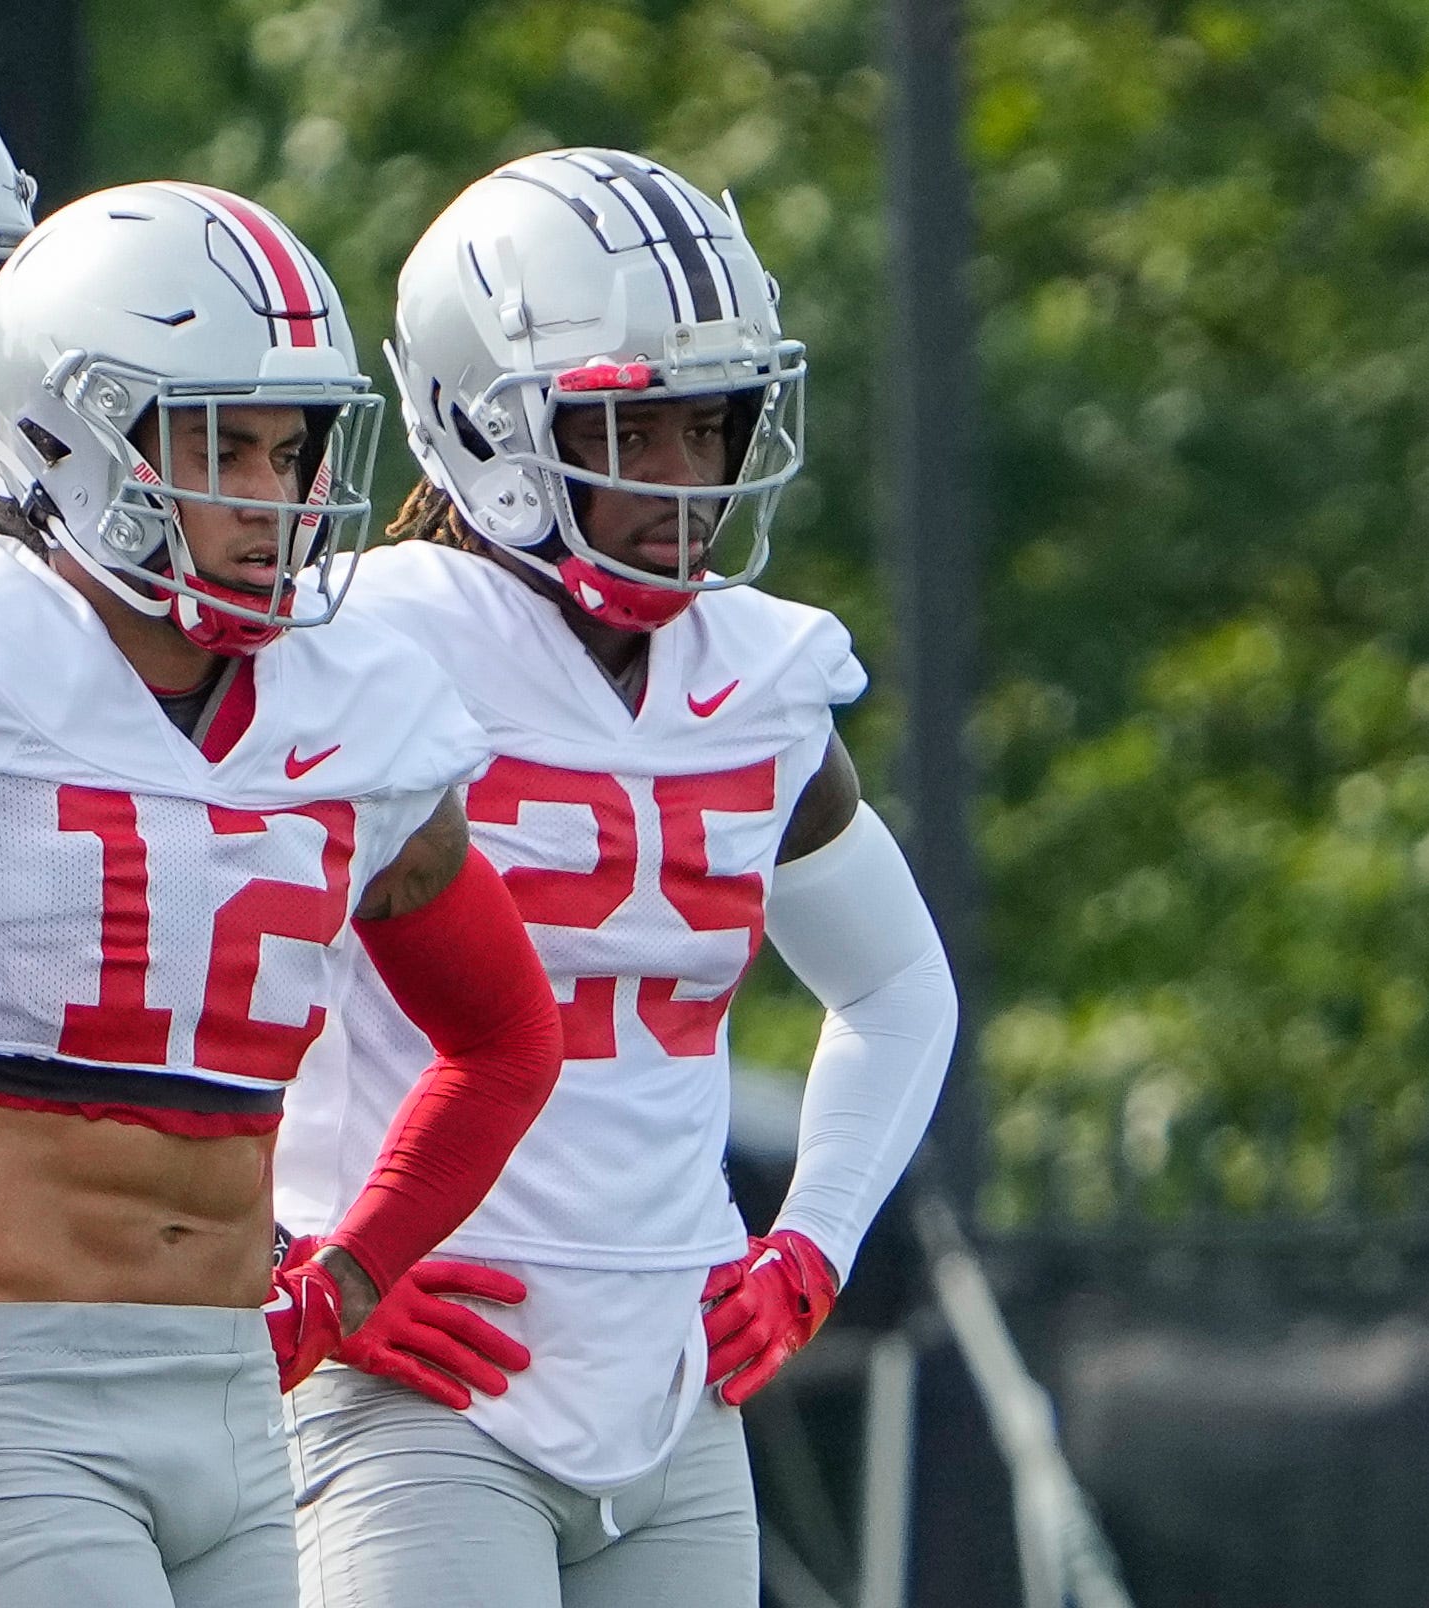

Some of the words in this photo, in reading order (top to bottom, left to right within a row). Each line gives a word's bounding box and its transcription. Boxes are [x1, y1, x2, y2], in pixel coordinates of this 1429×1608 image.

[300, 498, 324, 527] OHO
[57, 784, 356, 1081] 12
[465, 757, 776, 1062] 25
